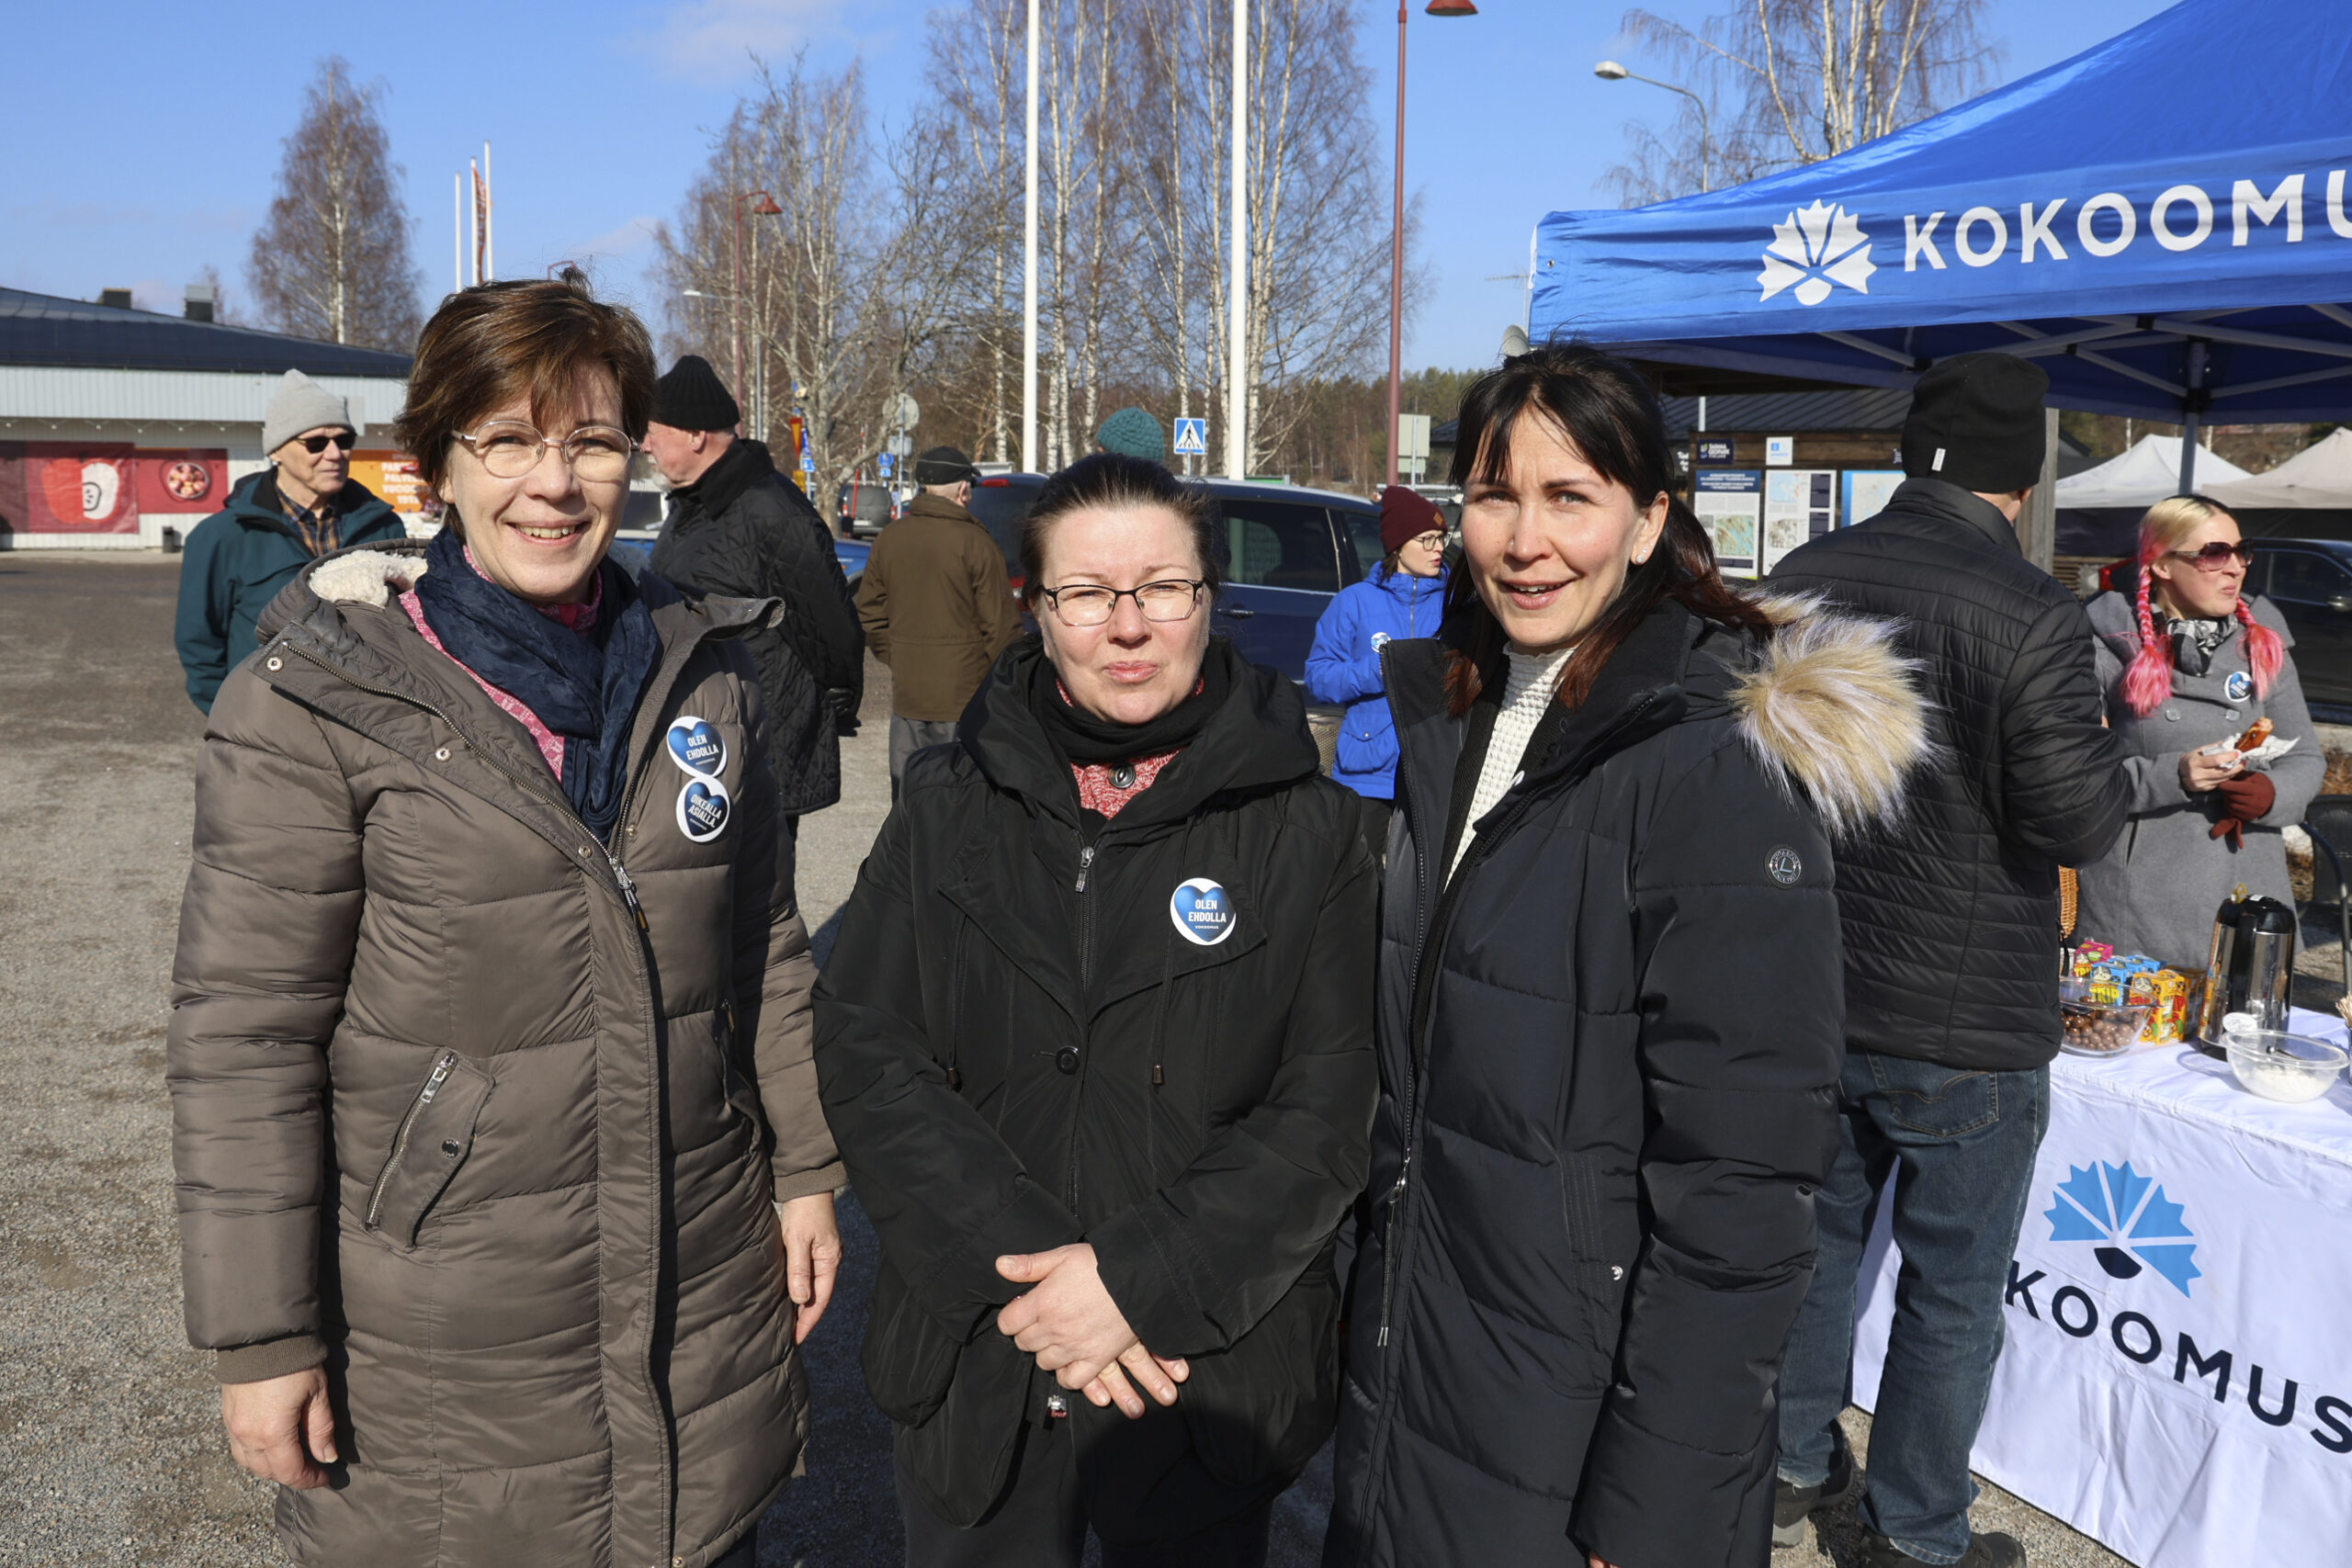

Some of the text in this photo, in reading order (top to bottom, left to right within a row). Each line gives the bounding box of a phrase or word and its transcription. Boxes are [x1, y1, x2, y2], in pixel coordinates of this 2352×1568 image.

[687, 734, 707, 747] OLEN
[685, 744, 719, 761] EHDOLLA
[690, 794, 722, 819] OIKEALLA
[1195, 899, 1218, 910] OLEN
[1188, 911, 1227, 923] EHDOLLA
